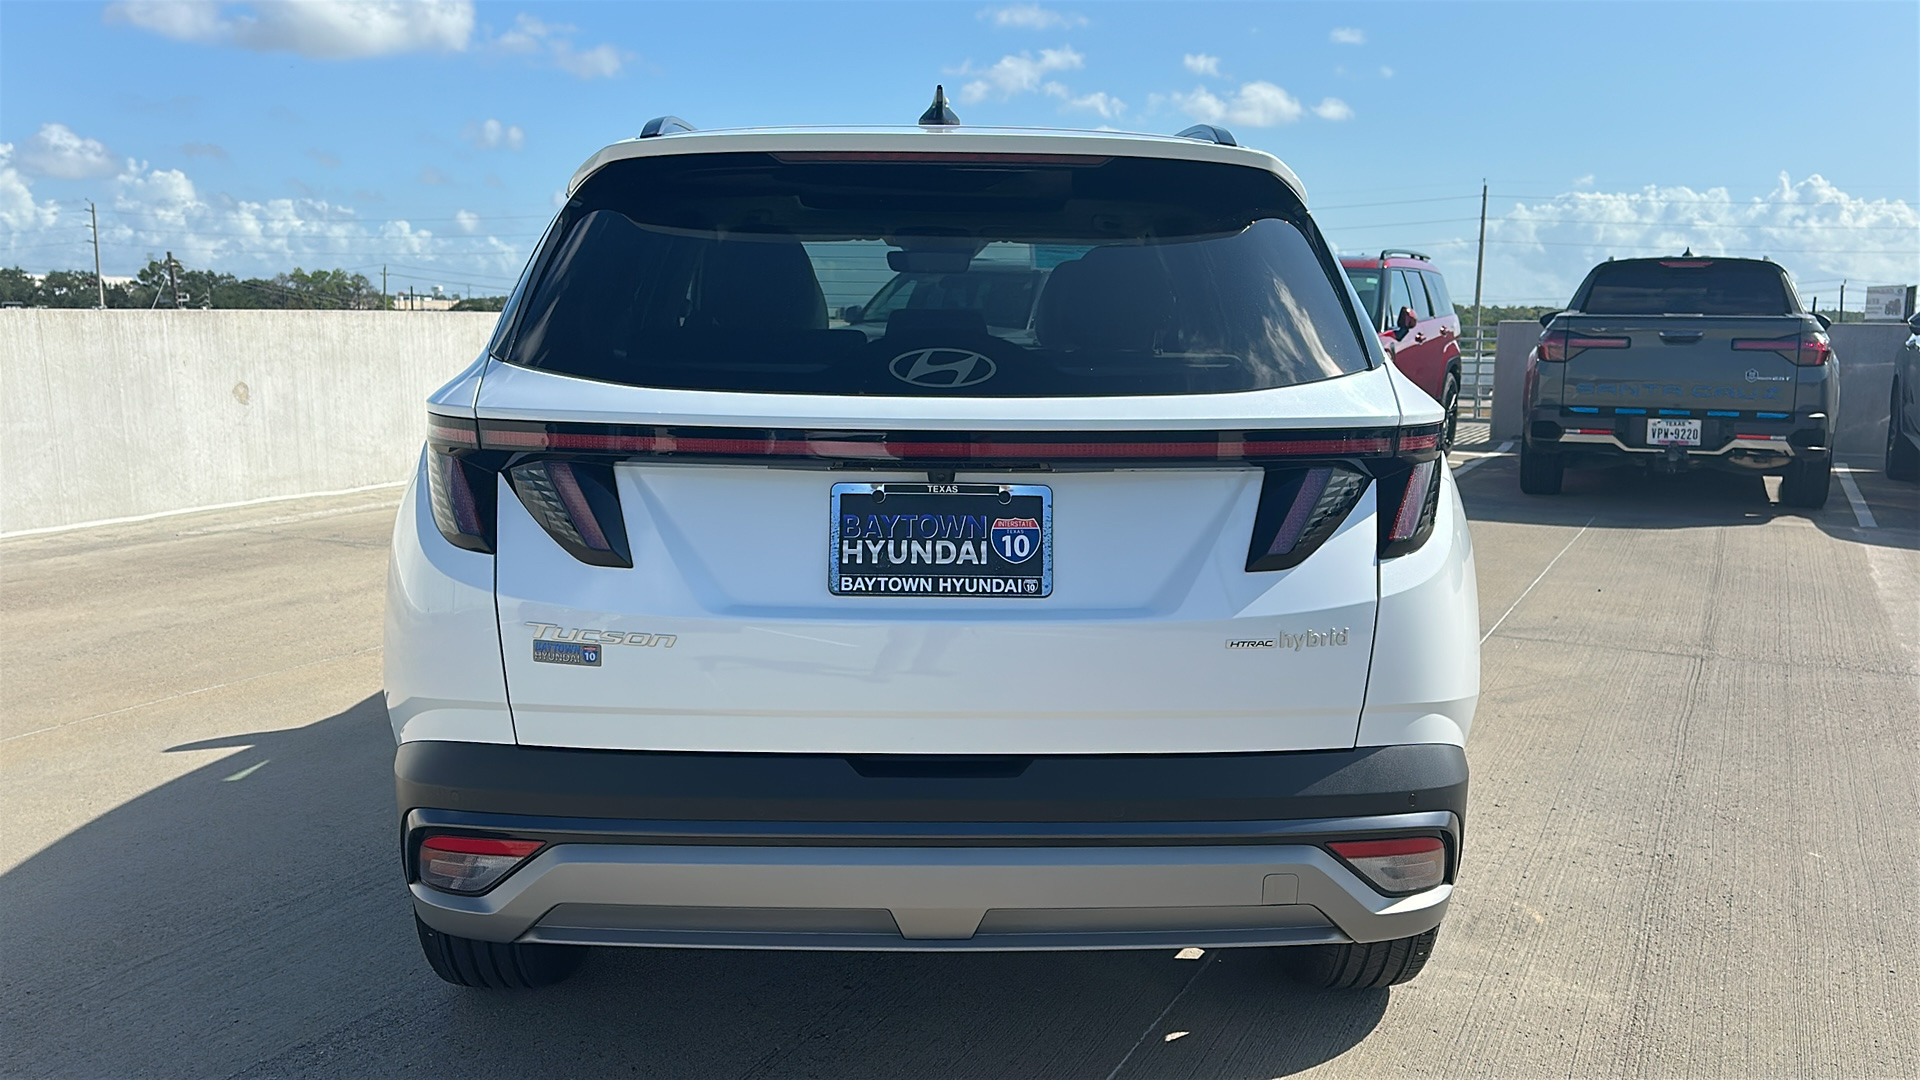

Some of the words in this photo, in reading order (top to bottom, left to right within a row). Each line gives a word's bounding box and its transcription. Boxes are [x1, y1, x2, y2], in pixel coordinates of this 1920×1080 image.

[1575, 383, 1682, 398] SANTA
[1692, 385, 1782, 400] CRUZ
[927, 485, 958, 493] TEXAS
[843, 514, 987, 538] BAYTOWN
[842, 540, 987, 564] HYUNDAI
[1001, 534, 1030, 557] 10
[840, 577, 932, 592] BAYTOWN
[938, 578, 1022, 593] HYUNDAI
[535, 642, 581, 652] BAYTOWN
[1230, 640, 1273, 648] HTRAC
[1279, 627, 1349, 652] hybrid
[534, 651, 580, 663] HYUNDAI
[585, 652, 596, 661] 10
